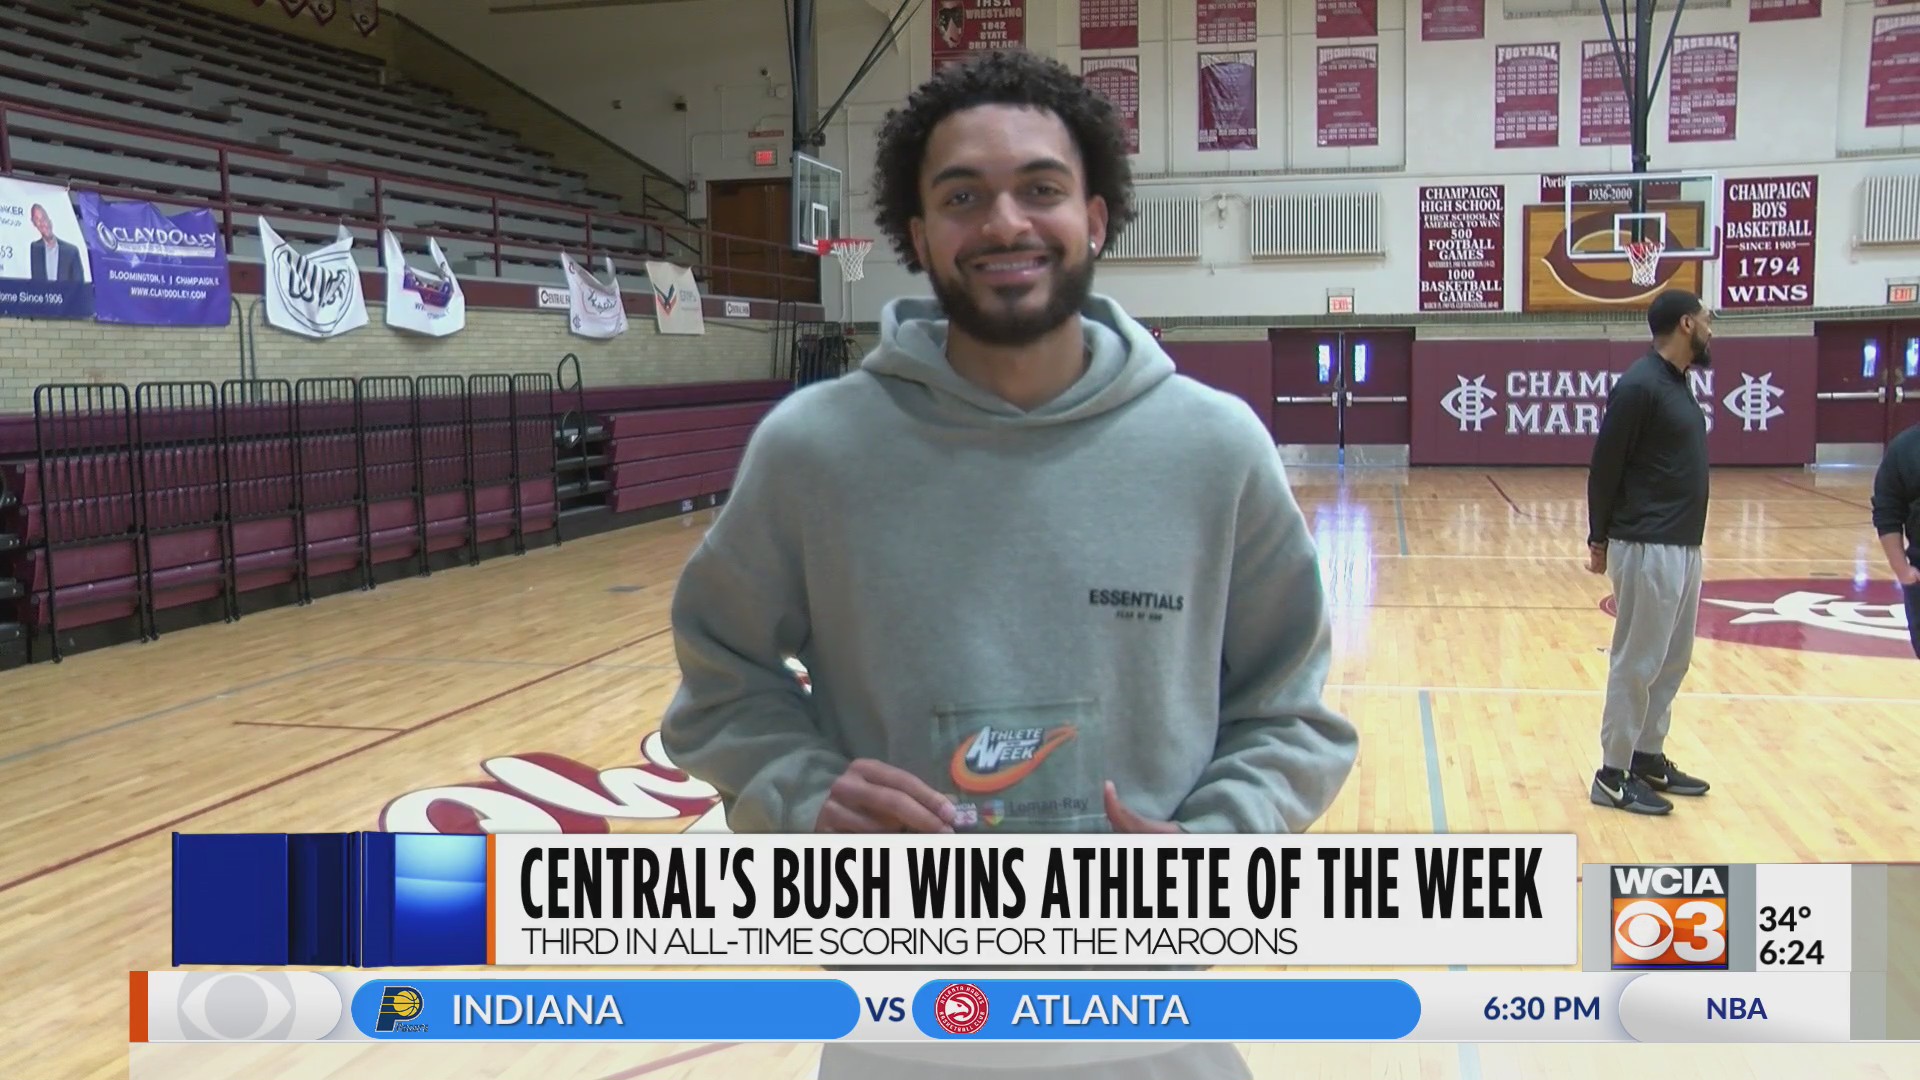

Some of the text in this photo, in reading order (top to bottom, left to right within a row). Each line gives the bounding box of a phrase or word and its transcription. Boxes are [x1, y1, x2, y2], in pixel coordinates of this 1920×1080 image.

[966, 8, 1023, 19] WRESTLING
[980, 31, 1008, 40] STATE
[1675, 35, 1737, 55] BASEBALL
[1498, 45, 1558, 64] FOOTBALL
[1425, 186, 1498, 200] CHAMPAIGN
[1729, 181, 1811, 201] CHAMPAIGN
[1421, 199, 1503, 212] HIGH SCHOOL
[1752, 201, 1787, 219] BOYS
[1423, 212, 1500, 222] FIRST SCHOOL IN
[1424, 220, 1464, 229] AMERICA
[1466, 220, 1478, 228] TO
[1726, 219, 1812, 239] BASKETBALL
[1450, 228, 1473, 240] 500
[1428, 238, 1495, 251] FOOTBALL
[1738, 241, 1772, 251] SINCE
[1438, 249, 1484, 260] GAMES
[1739, 256, 1800, 277] 1794
[1448, 268, 1475, 280] 1000
[1421, 279, 1502, 292] BASKETBALL
[0, 293, 17, 302] ome
[19, 292, 44, 302] Since
[1438, 290, 1484, 302] GAMES
[1727, 284, 1808, 302] WINS
[1089, 588, 1184, 611] ESSENTIALS
[978, 741, 1035, 768] WEEK
